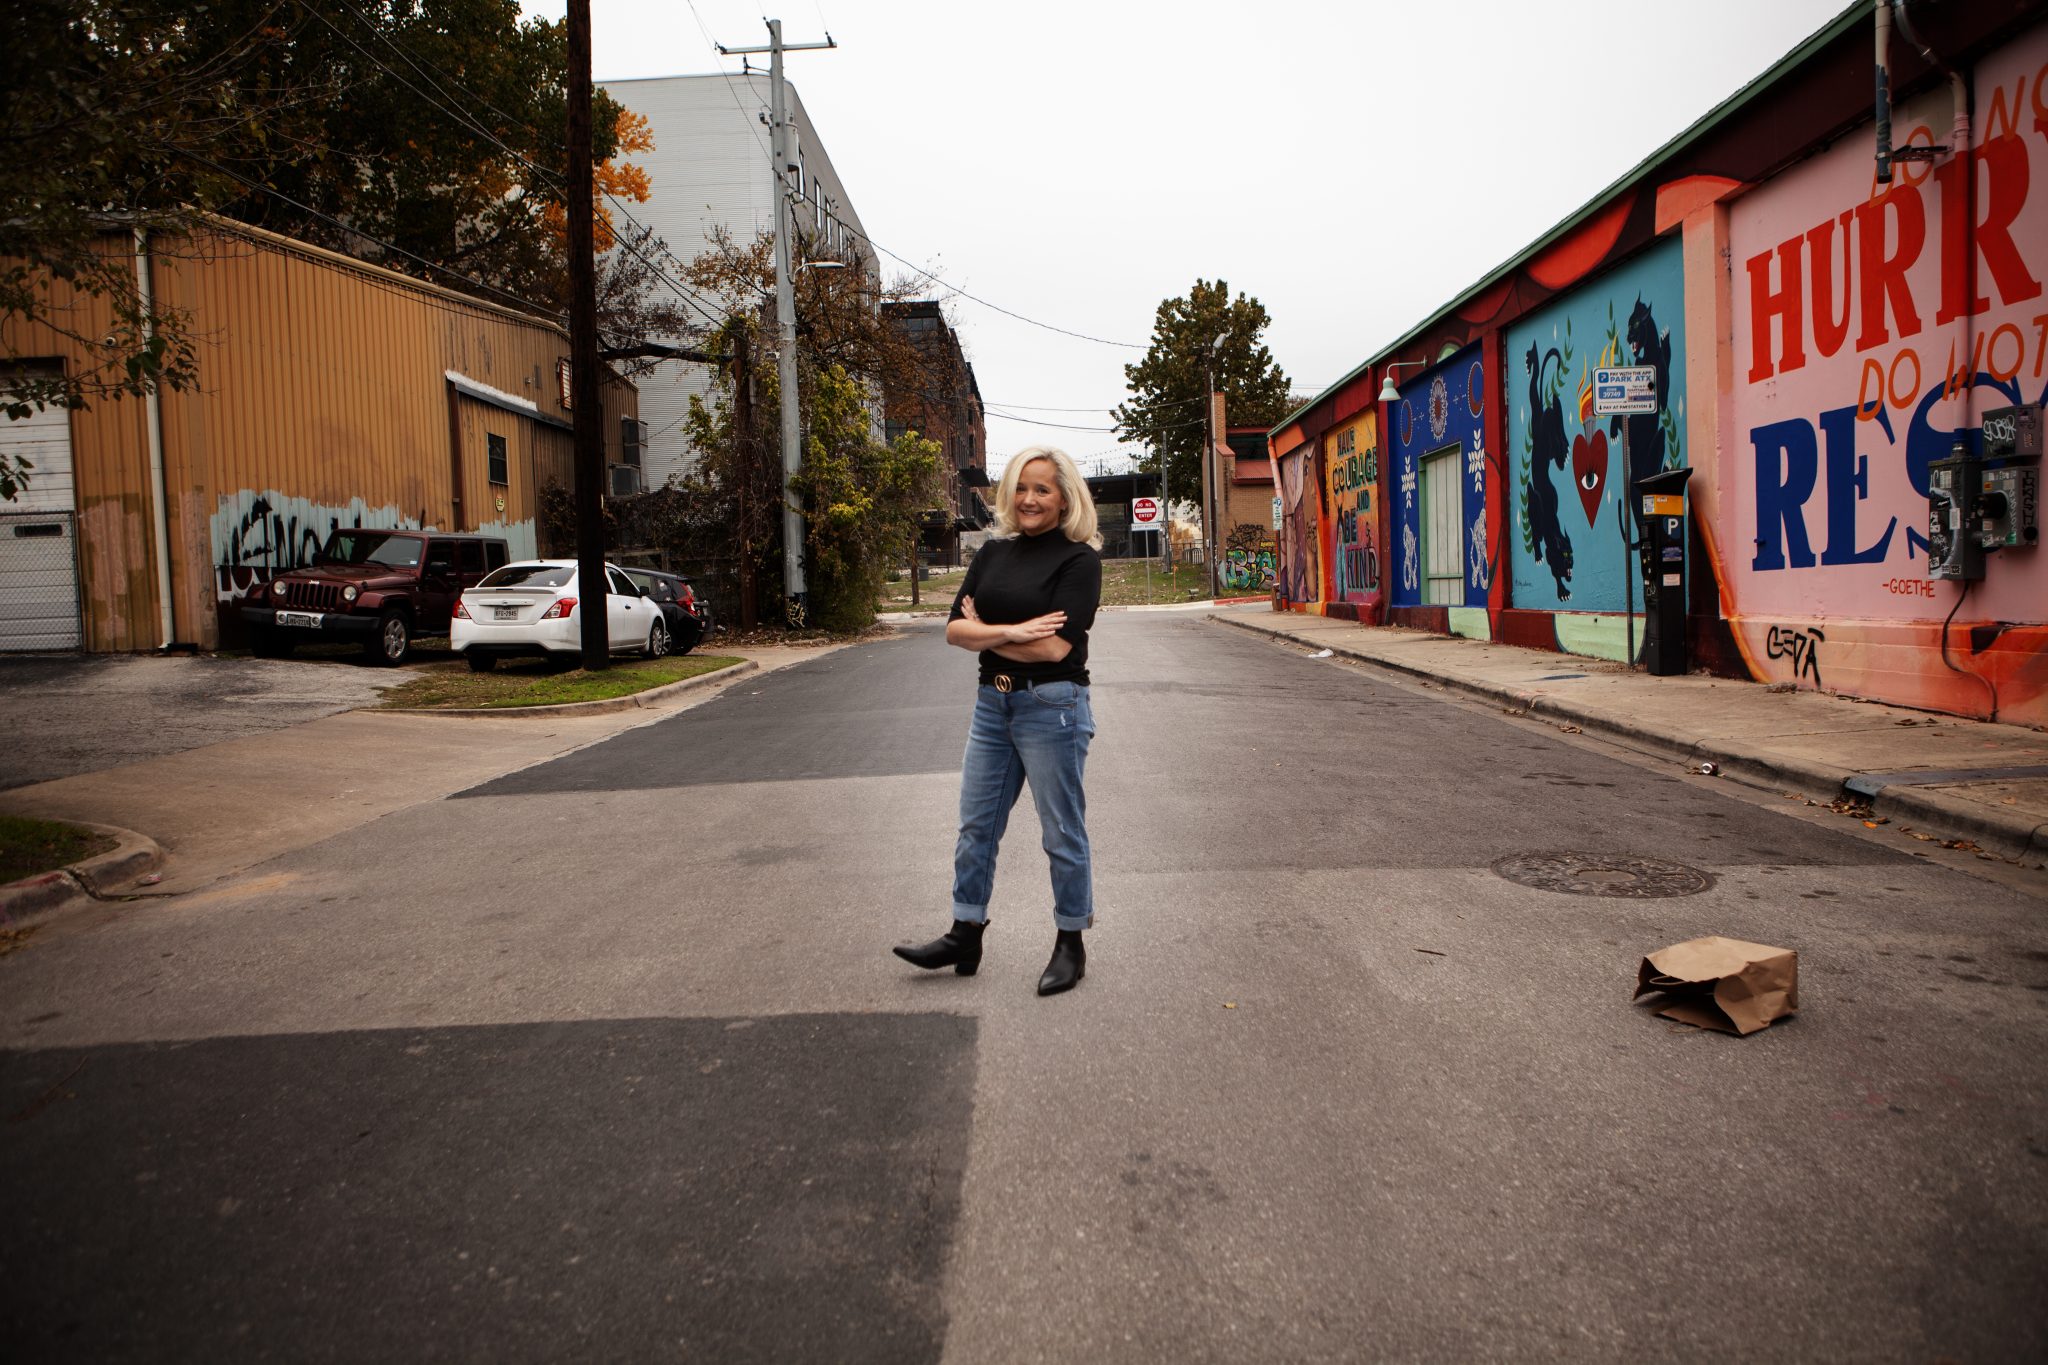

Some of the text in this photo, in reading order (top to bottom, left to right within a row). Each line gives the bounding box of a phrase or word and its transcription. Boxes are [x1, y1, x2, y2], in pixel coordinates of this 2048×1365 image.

[1746, 118, 2048, 384] HURR
[1857, 348, 1921, 421] DO
[1337, 427, 1356, 457] HAVE
[1333, 447, 1377, 494] COURAGE
[1750, 372, 2048, 572] RES
[1356, 489, 1371, 513] AND
[1344, 507, 1358, 545] BE
[1667, 518, 1679, 535] P
[1347, 547, 1380, 592] KIND
